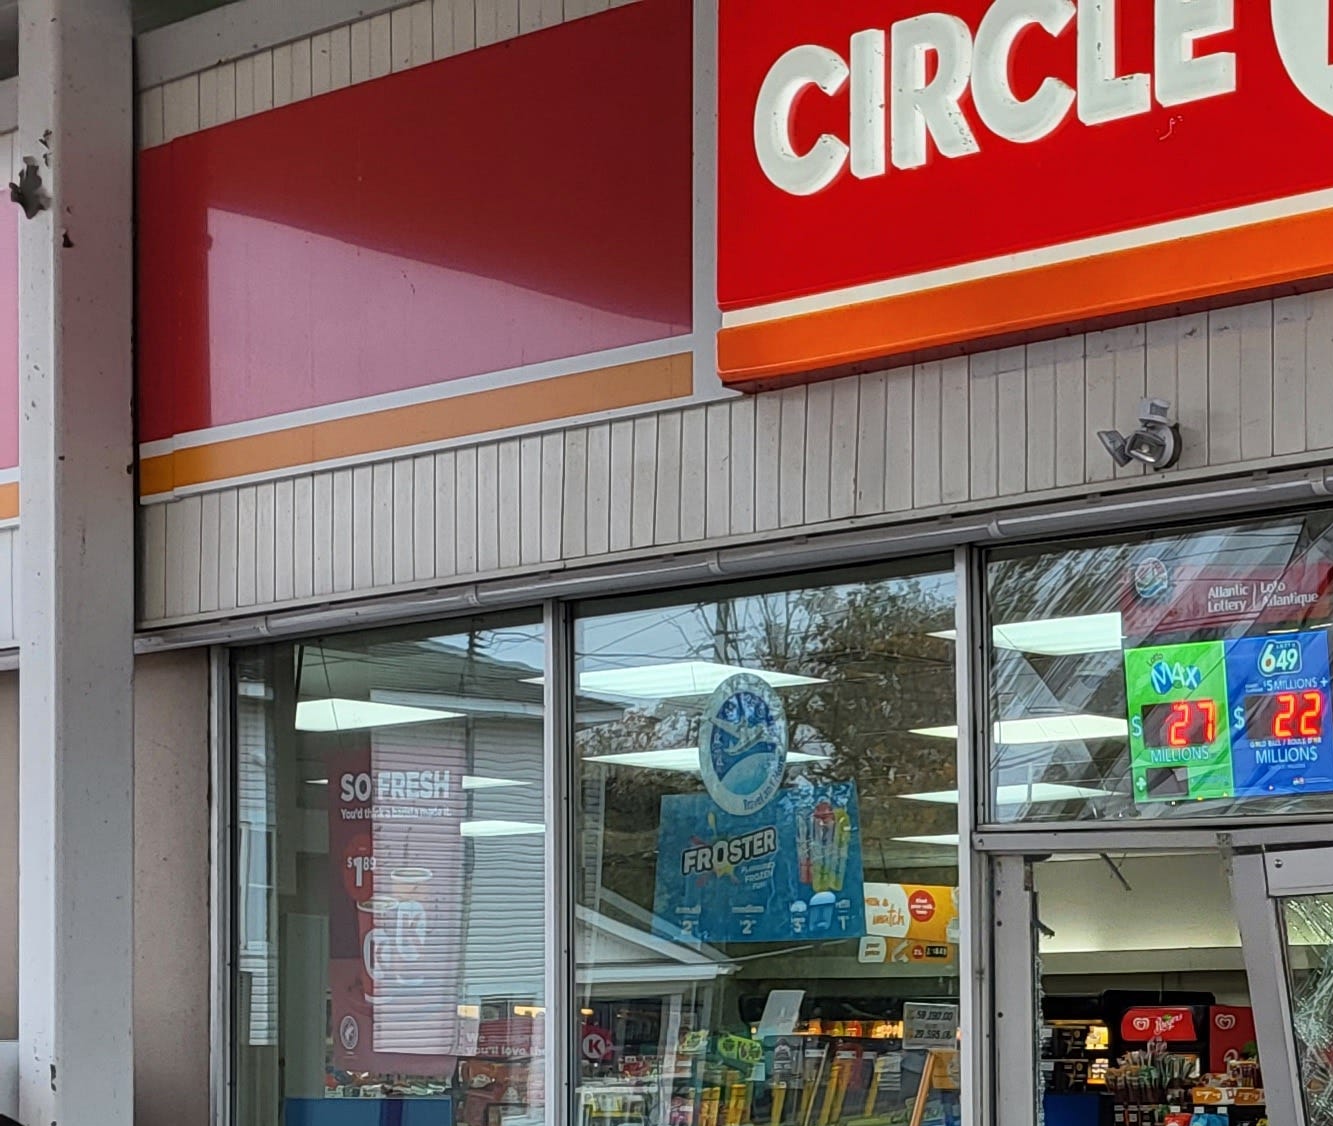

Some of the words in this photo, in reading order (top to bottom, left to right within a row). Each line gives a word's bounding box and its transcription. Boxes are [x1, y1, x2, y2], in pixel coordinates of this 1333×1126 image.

[754, 0, 1237, 196] CIRCLE
[1207, 583, 1250, 600] Atlantic
[1207, 599, 1248, 613] Lottery
[1150, 661, 1201, 695] MAX
[1168, 700, 1216, 747] 27
[1273, 690, 1324, 740] 22
[1151, 745, 1209, 763] MILLIONS
[1255, 746, 1319, 765] MILLIONS
[340, 772, 371, 802] SO
[377, 770, 451, 801] FRESH
[340, 808, 363, 820] You'd
[682, 826, 777, 875] FROSTER
